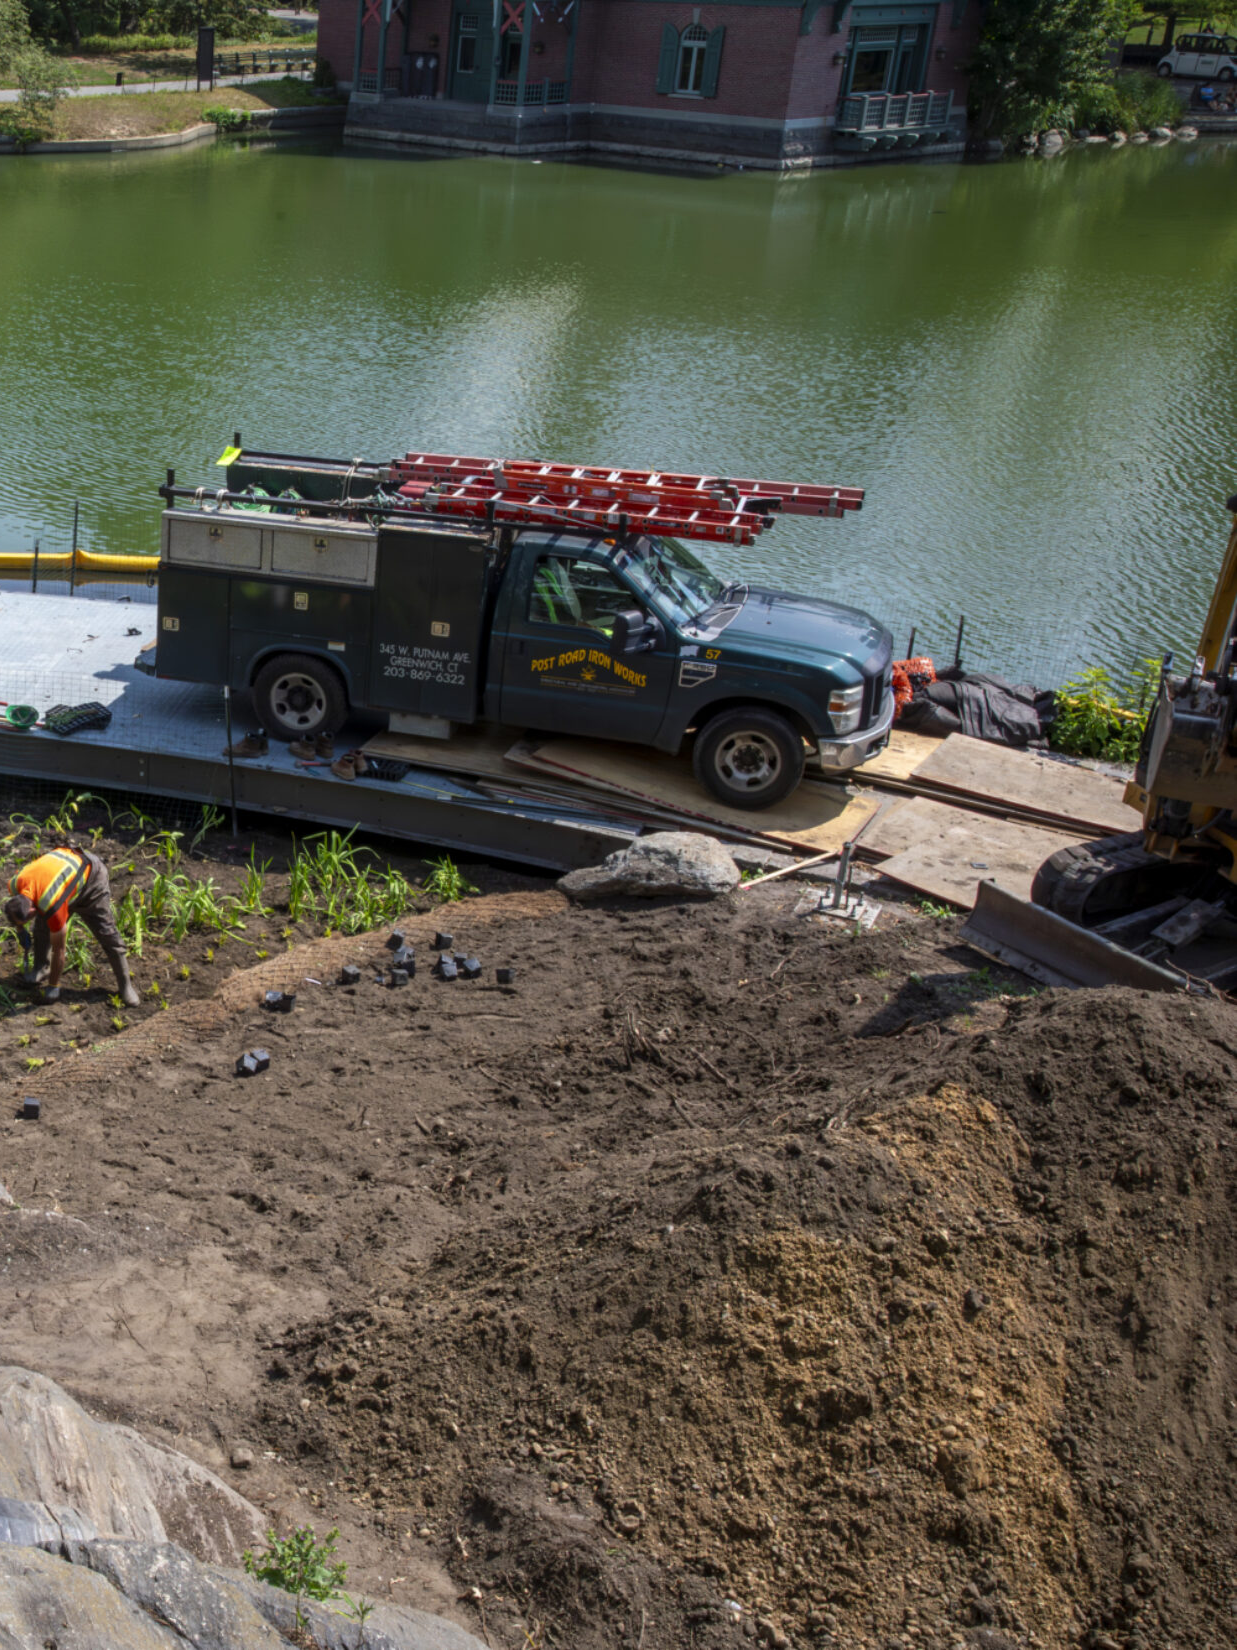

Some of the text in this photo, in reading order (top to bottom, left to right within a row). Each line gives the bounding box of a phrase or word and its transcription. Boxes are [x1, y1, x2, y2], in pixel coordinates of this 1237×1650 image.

[379, 643, 396, 655] 345
[398, 645, 410, 657] W.
[413, 647, 450, 661] PUTNAM
[706, 648, 722, 660] 57
[383, 666, 466, 686] 203-869-6322
[447, 662, 459, 673] CT
[531, 656, 556, 672] POST
[558, 649, 587, 667] ROAD
[588, 649, 612, 670] IRON
[613, 660, 647, 688] WORKS
